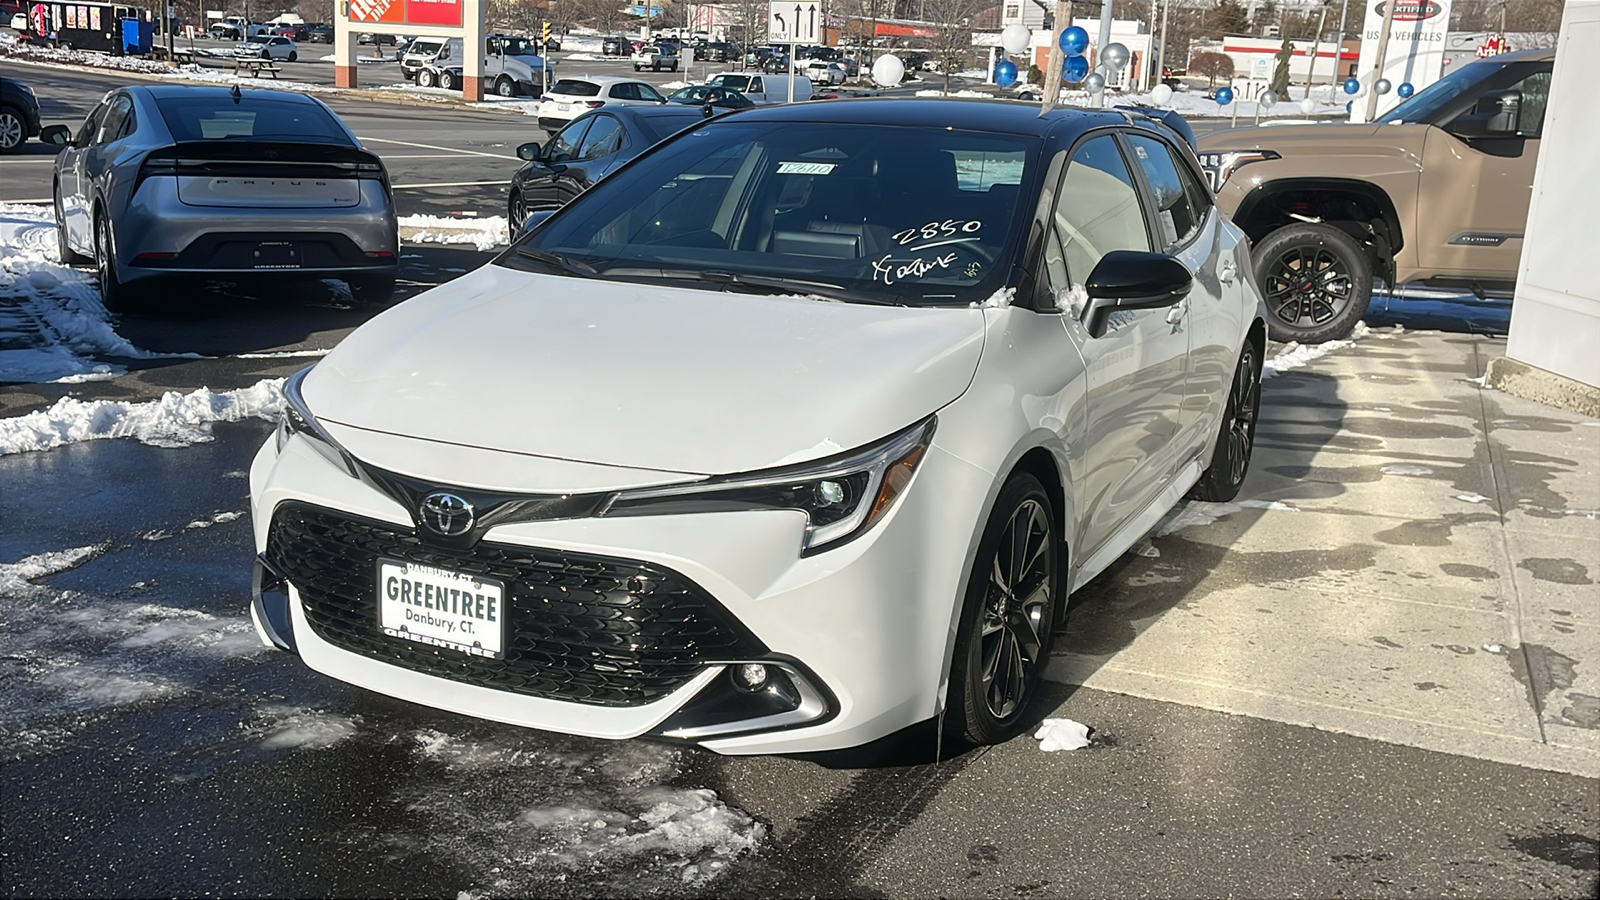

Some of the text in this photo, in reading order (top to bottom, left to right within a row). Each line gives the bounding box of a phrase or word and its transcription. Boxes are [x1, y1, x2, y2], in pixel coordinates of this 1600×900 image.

[1366, 31, 1442, 41] USD VEHICLES
[892, 219, 982, 245] 2850
[406, 562, 457, 581] DANBURY,
[387, 576, 497, 622] GREENTREE
[406, 608, 475, 635] Danbury, CT.
[384, 628, 496, 659] GREENTREE
